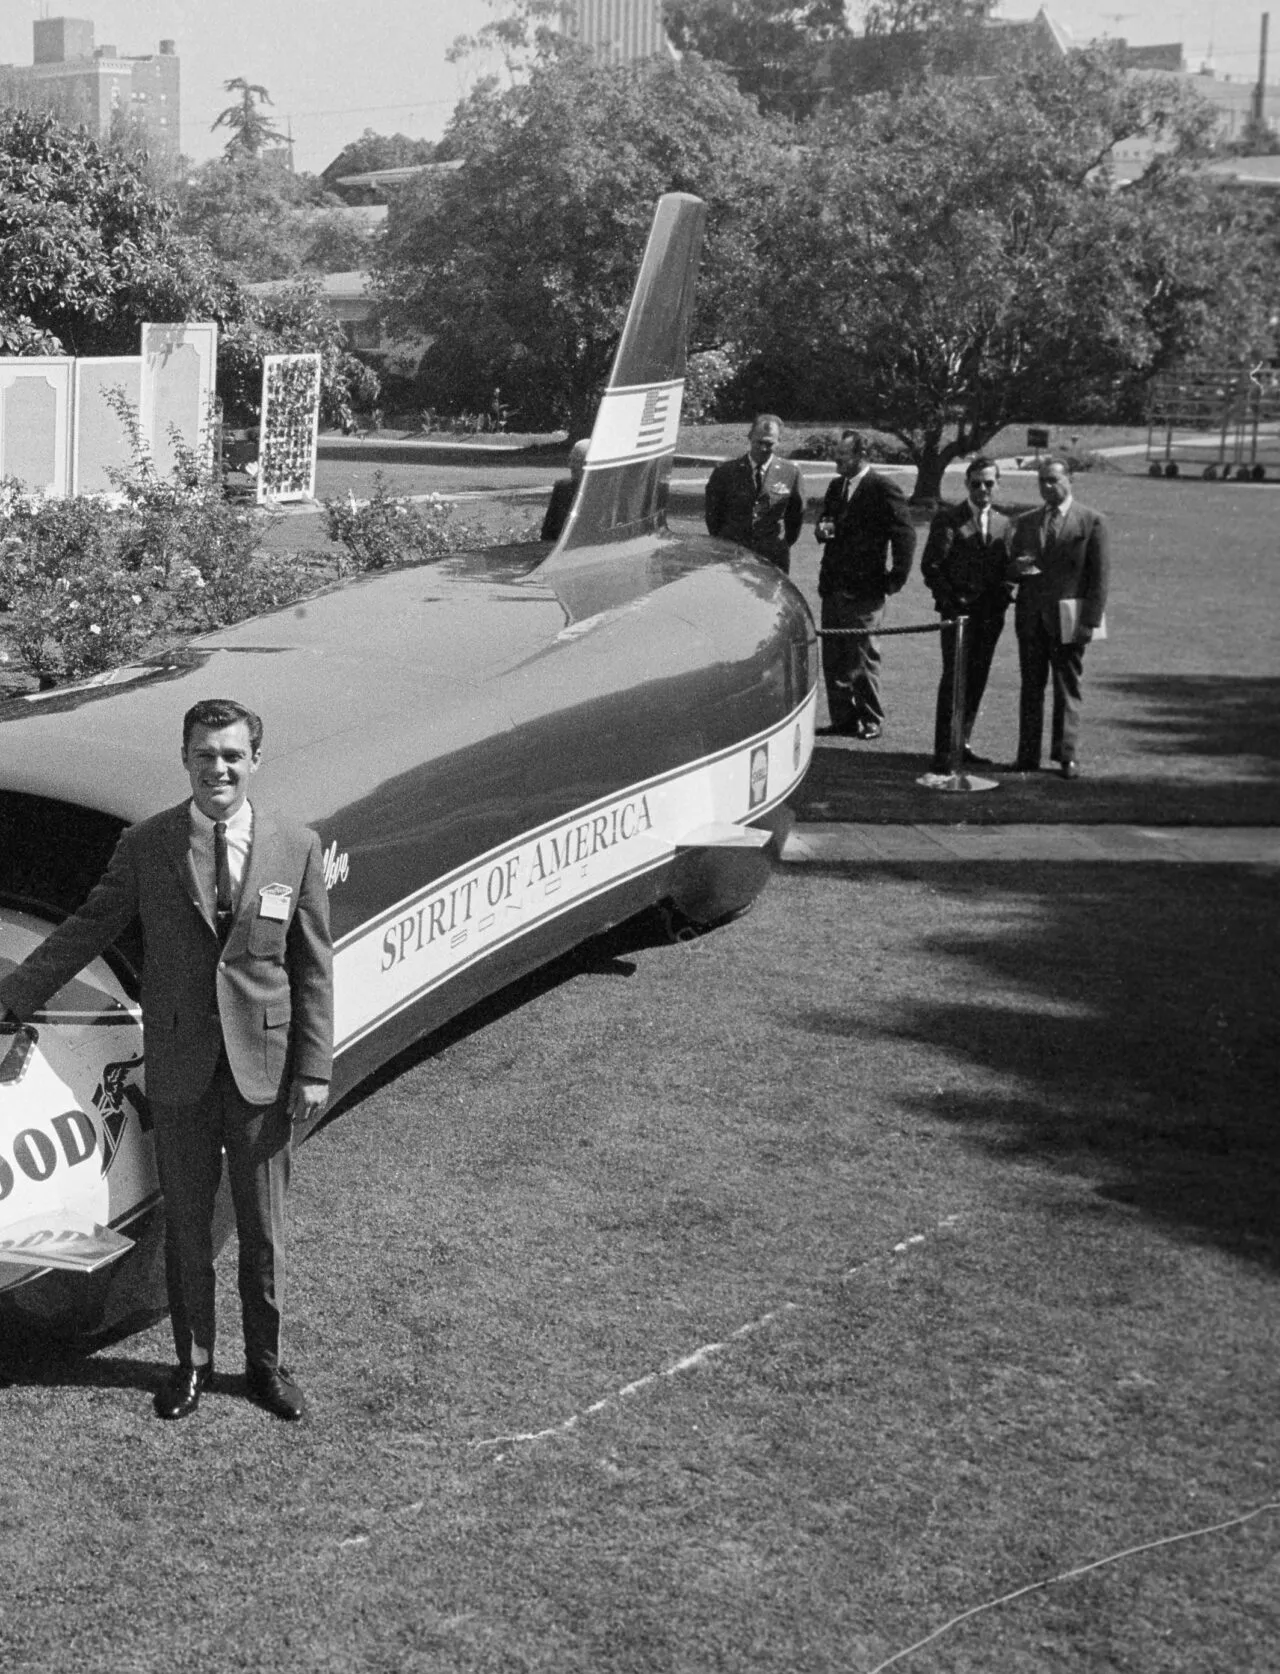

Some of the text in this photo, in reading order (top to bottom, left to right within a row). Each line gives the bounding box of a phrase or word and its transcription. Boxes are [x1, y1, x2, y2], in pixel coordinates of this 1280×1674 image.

[381, 795, 653, 972] SPIRIT OF AMERICA
